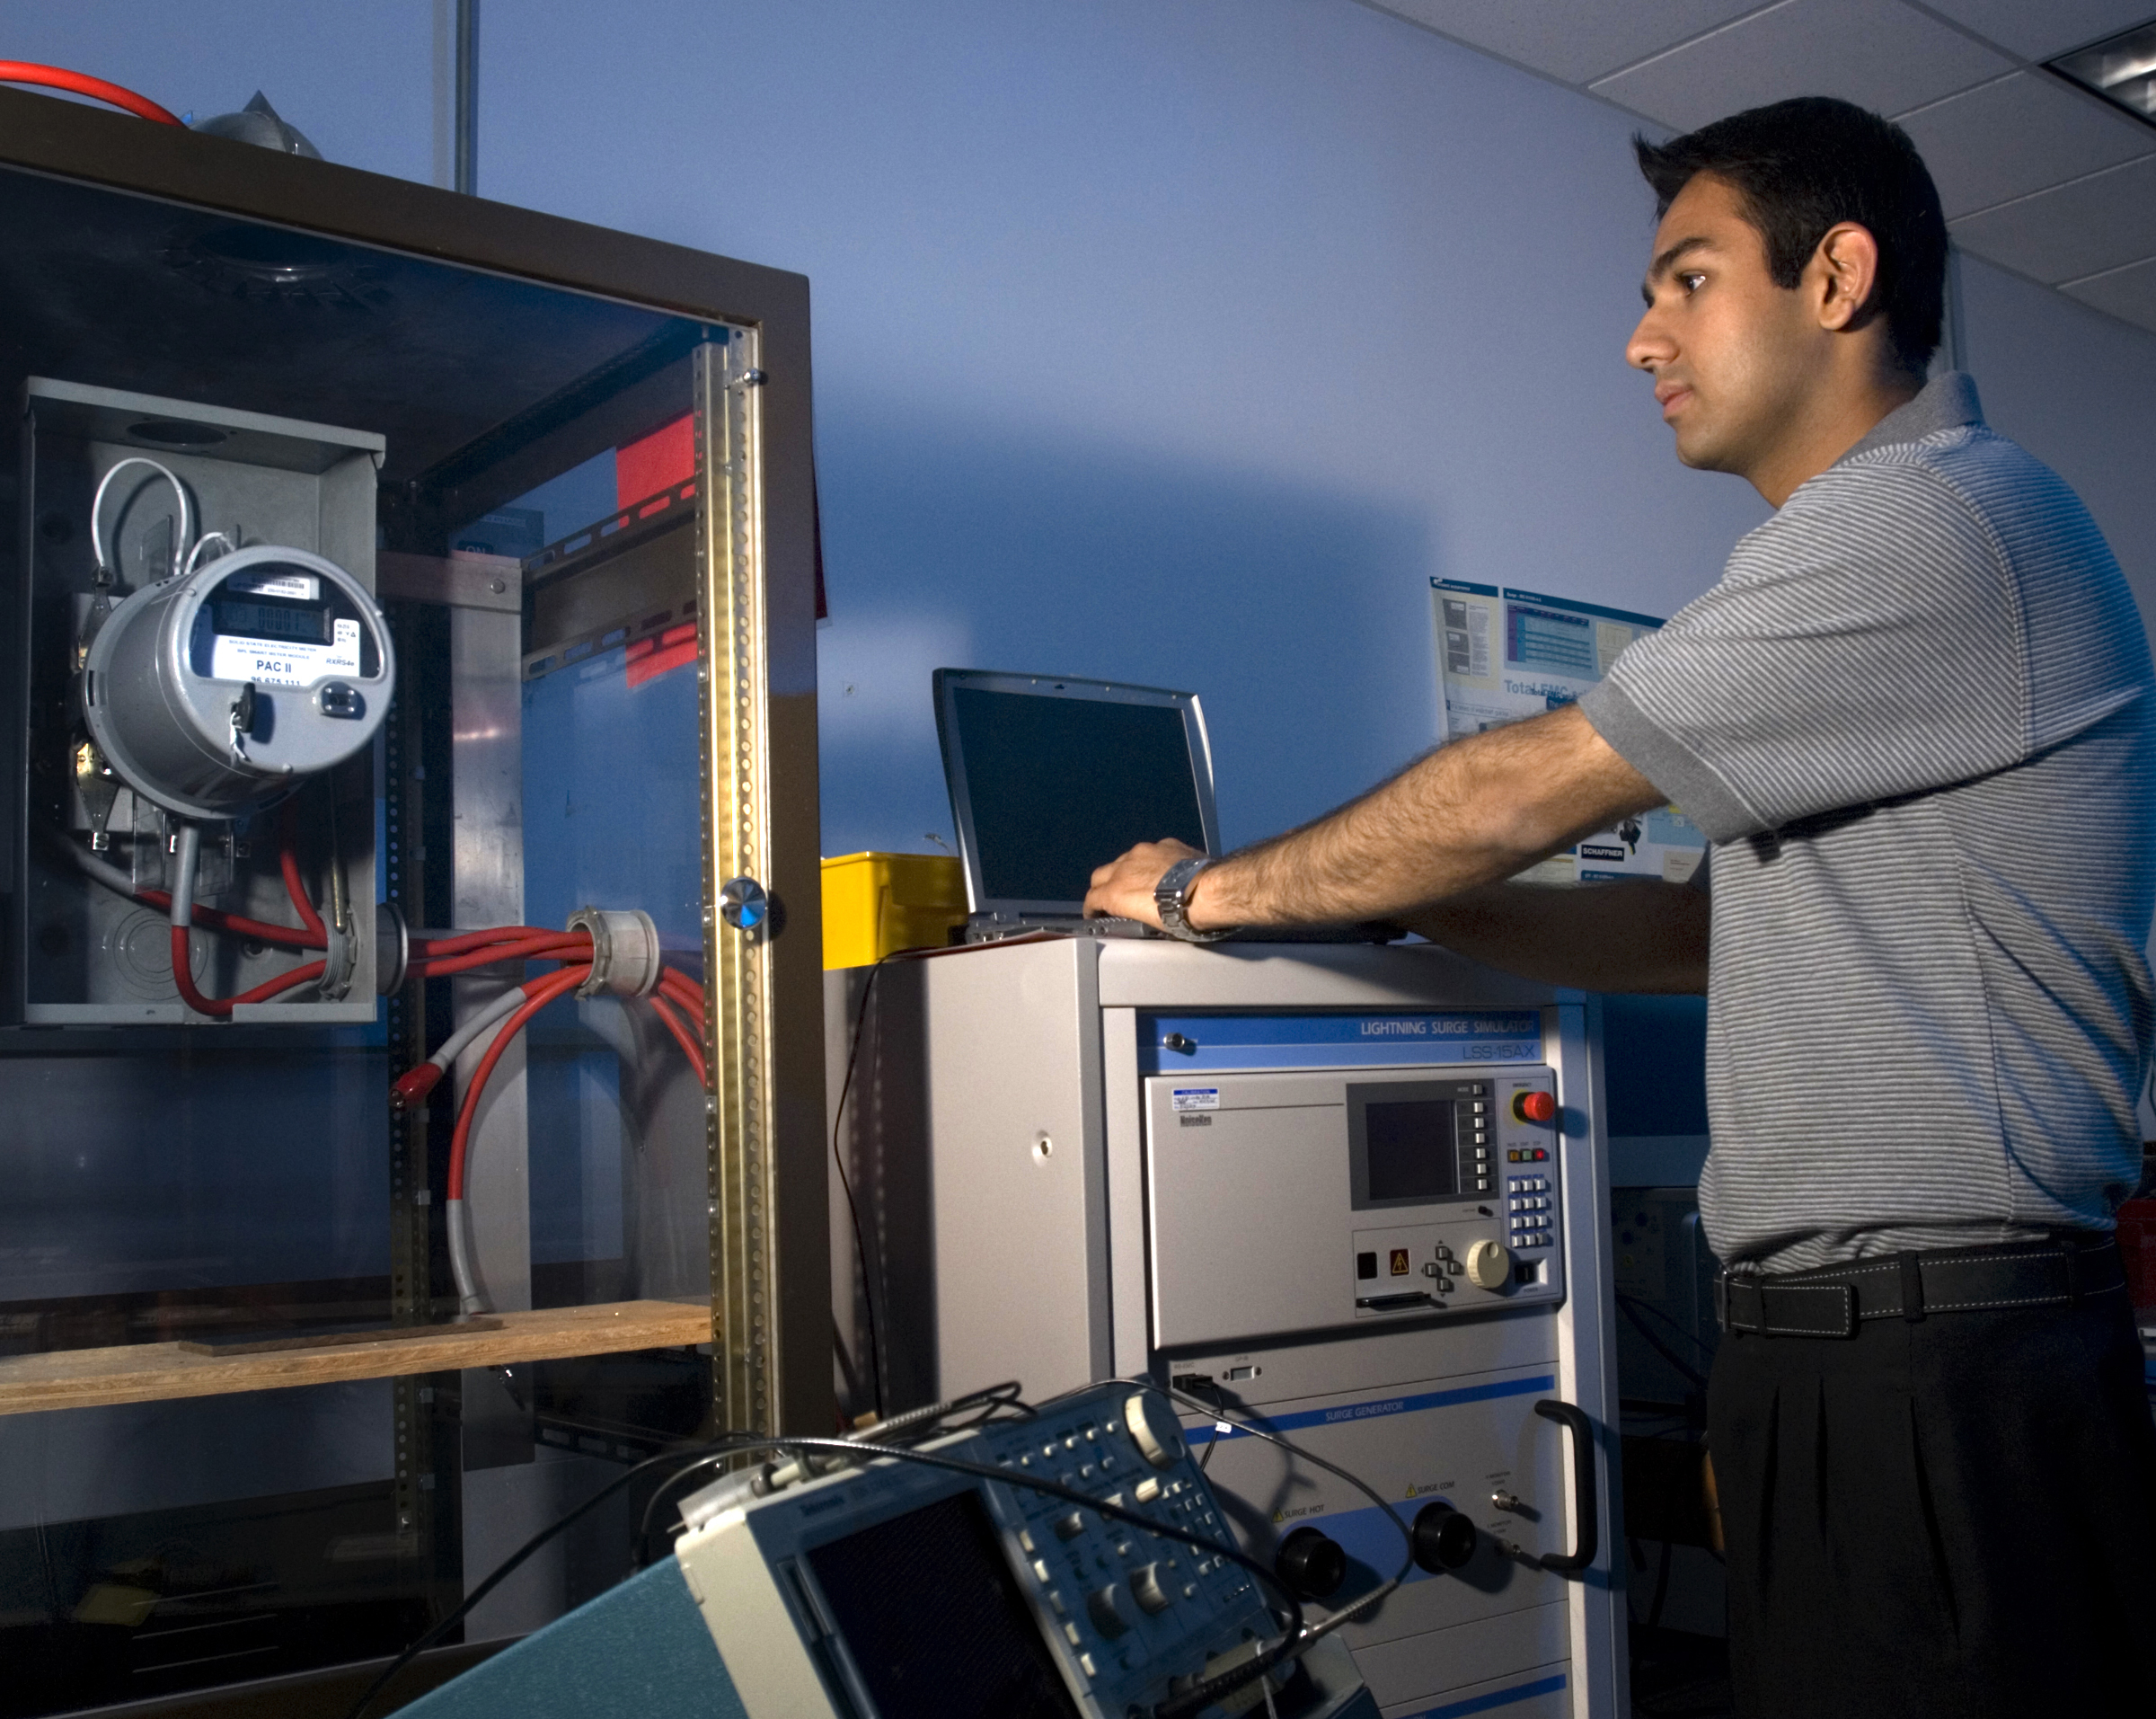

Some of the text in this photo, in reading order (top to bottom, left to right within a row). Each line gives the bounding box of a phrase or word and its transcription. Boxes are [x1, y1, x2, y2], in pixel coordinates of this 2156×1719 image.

[256, 659, 282, 672] PAC
[1504, 678, 1535, 696] Total
[1582, 847, 1623, 857] SCHAFFNER
[1360, 1020, 1534, 1035] LIGHTNING SURGE SIMULATOR
[1462, 1045, 1536, 1060] LSS-15AX
[1325, 1401, 1404, 1422] SURGE GENERATOR
[1418, 1480, 1455, 1495] SURGE COM
[1284, 1503, 1325, 1520] SURGE HOT
